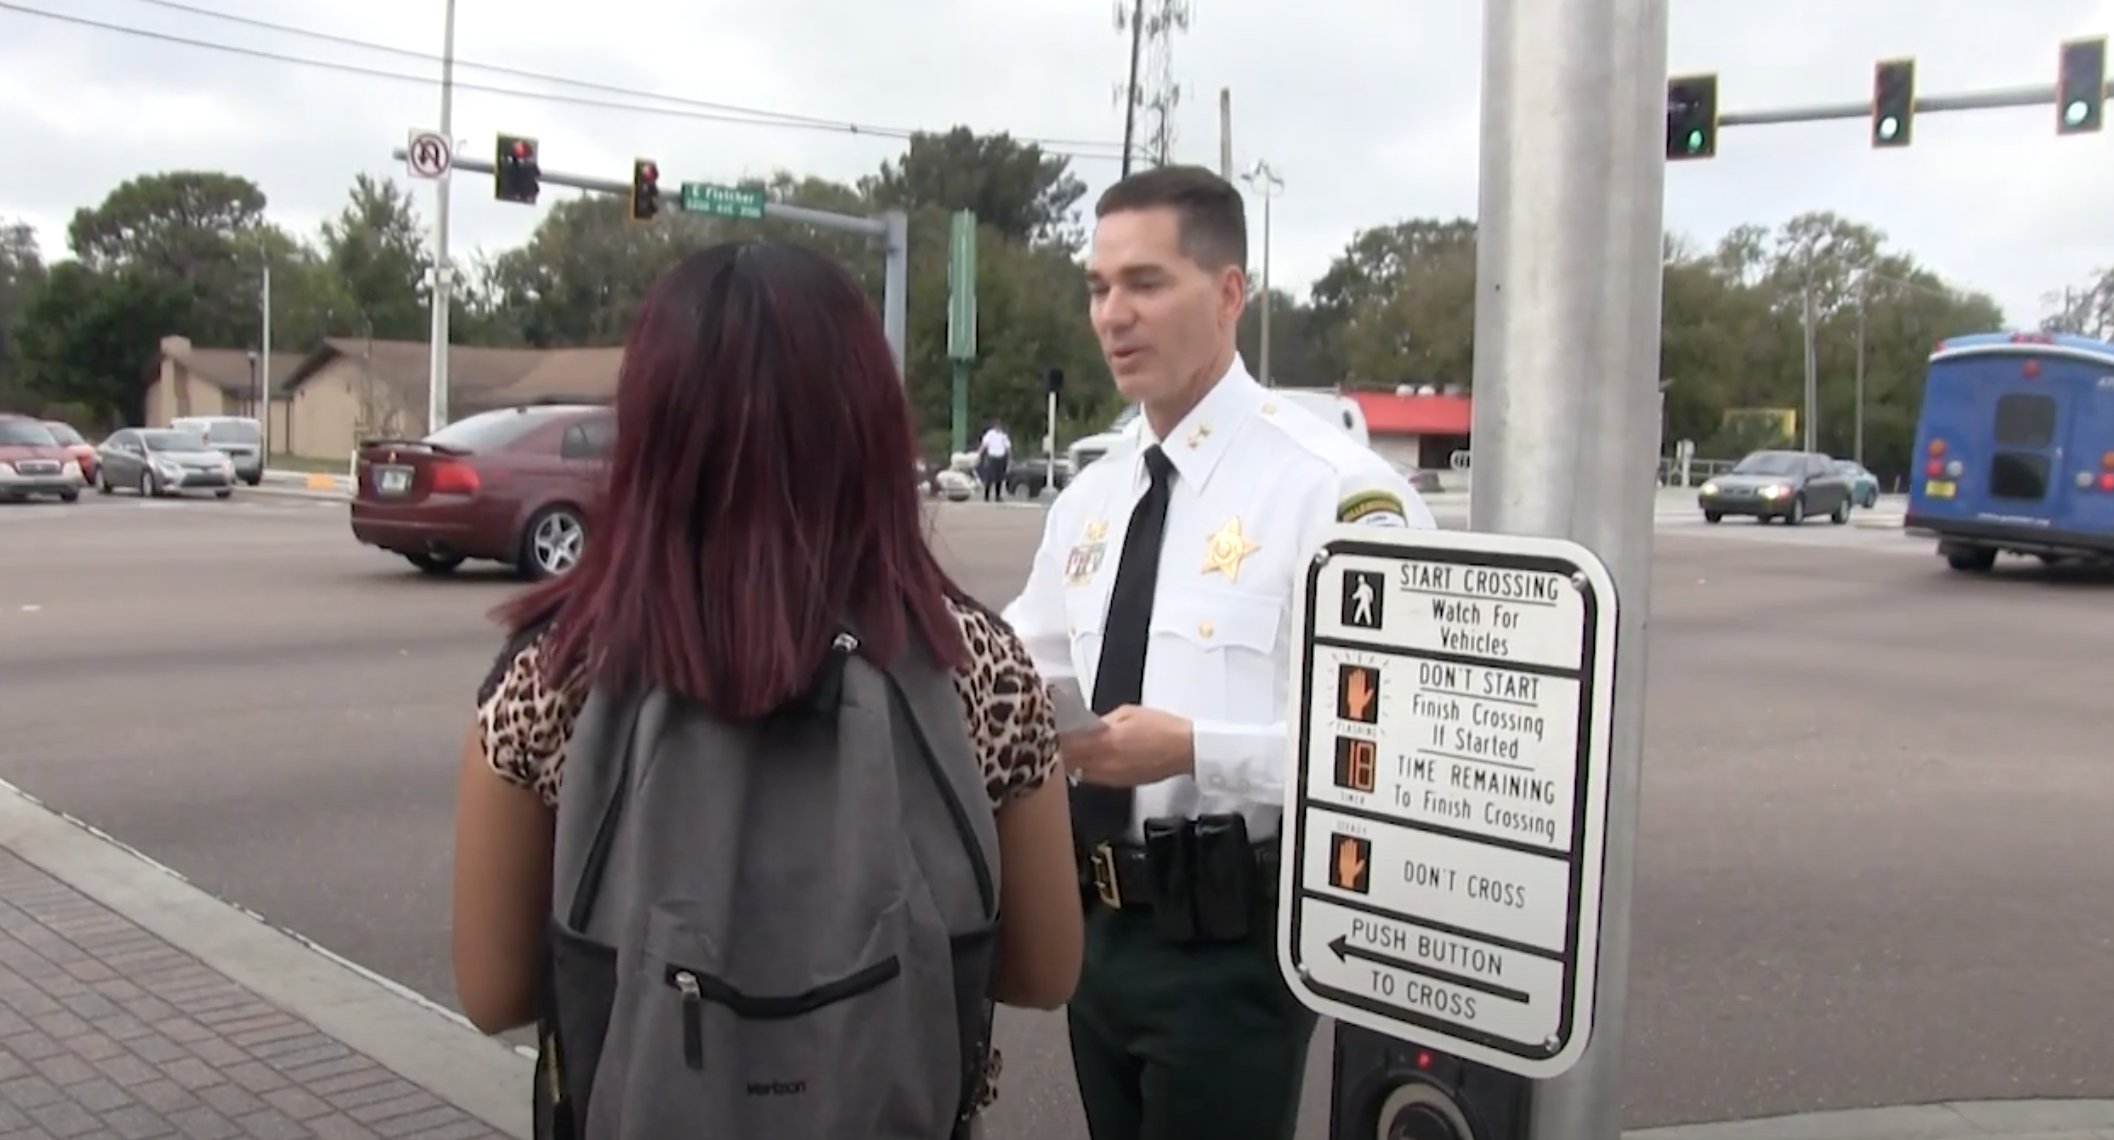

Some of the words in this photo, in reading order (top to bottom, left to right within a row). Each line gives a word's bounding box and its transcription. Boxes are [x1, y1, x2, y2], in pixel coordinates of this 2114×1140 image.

[705, 186, 754, 206] Fletcher
[1399, 563, 1452, 590] START
[1463, 568, 1559, 601] CROSSING
[1432, 598, 1481, 626] Watch
[1493, 604, 1520, 630] For
[1440, 626, 1509, 656] Vehicles
[1419, 661, 1472, 691] DON'T
[1483, 670, 1540, 701] START
[1412, 694, 1460, 720] Finish
[1472, 704, 1545, 742] Crossing
[1433, 723, 1447, 748] If
[1454, 728, 1519, 760] Started
[1397, 754, 1436, 783] TIME
[1451, 762, 1556, 805] REMAINING
[1393, 783, 1412, 807] To
[1422, 790, 1472, 820] Finish
[1484, 803, 1556, 843] Crossing
[1403, 860, 1456, 892] DON'T
[1467, 875, 1527, 909] CROSS
[1351, 918, 1407, 952] PUSH
[1418, 935, 1503, 977] BUTTON
[1371, 970, 1395, 997] TO
[1407, 981, 1477, 1020] CROSS
[746, 1078, 807, 1097] verizon
